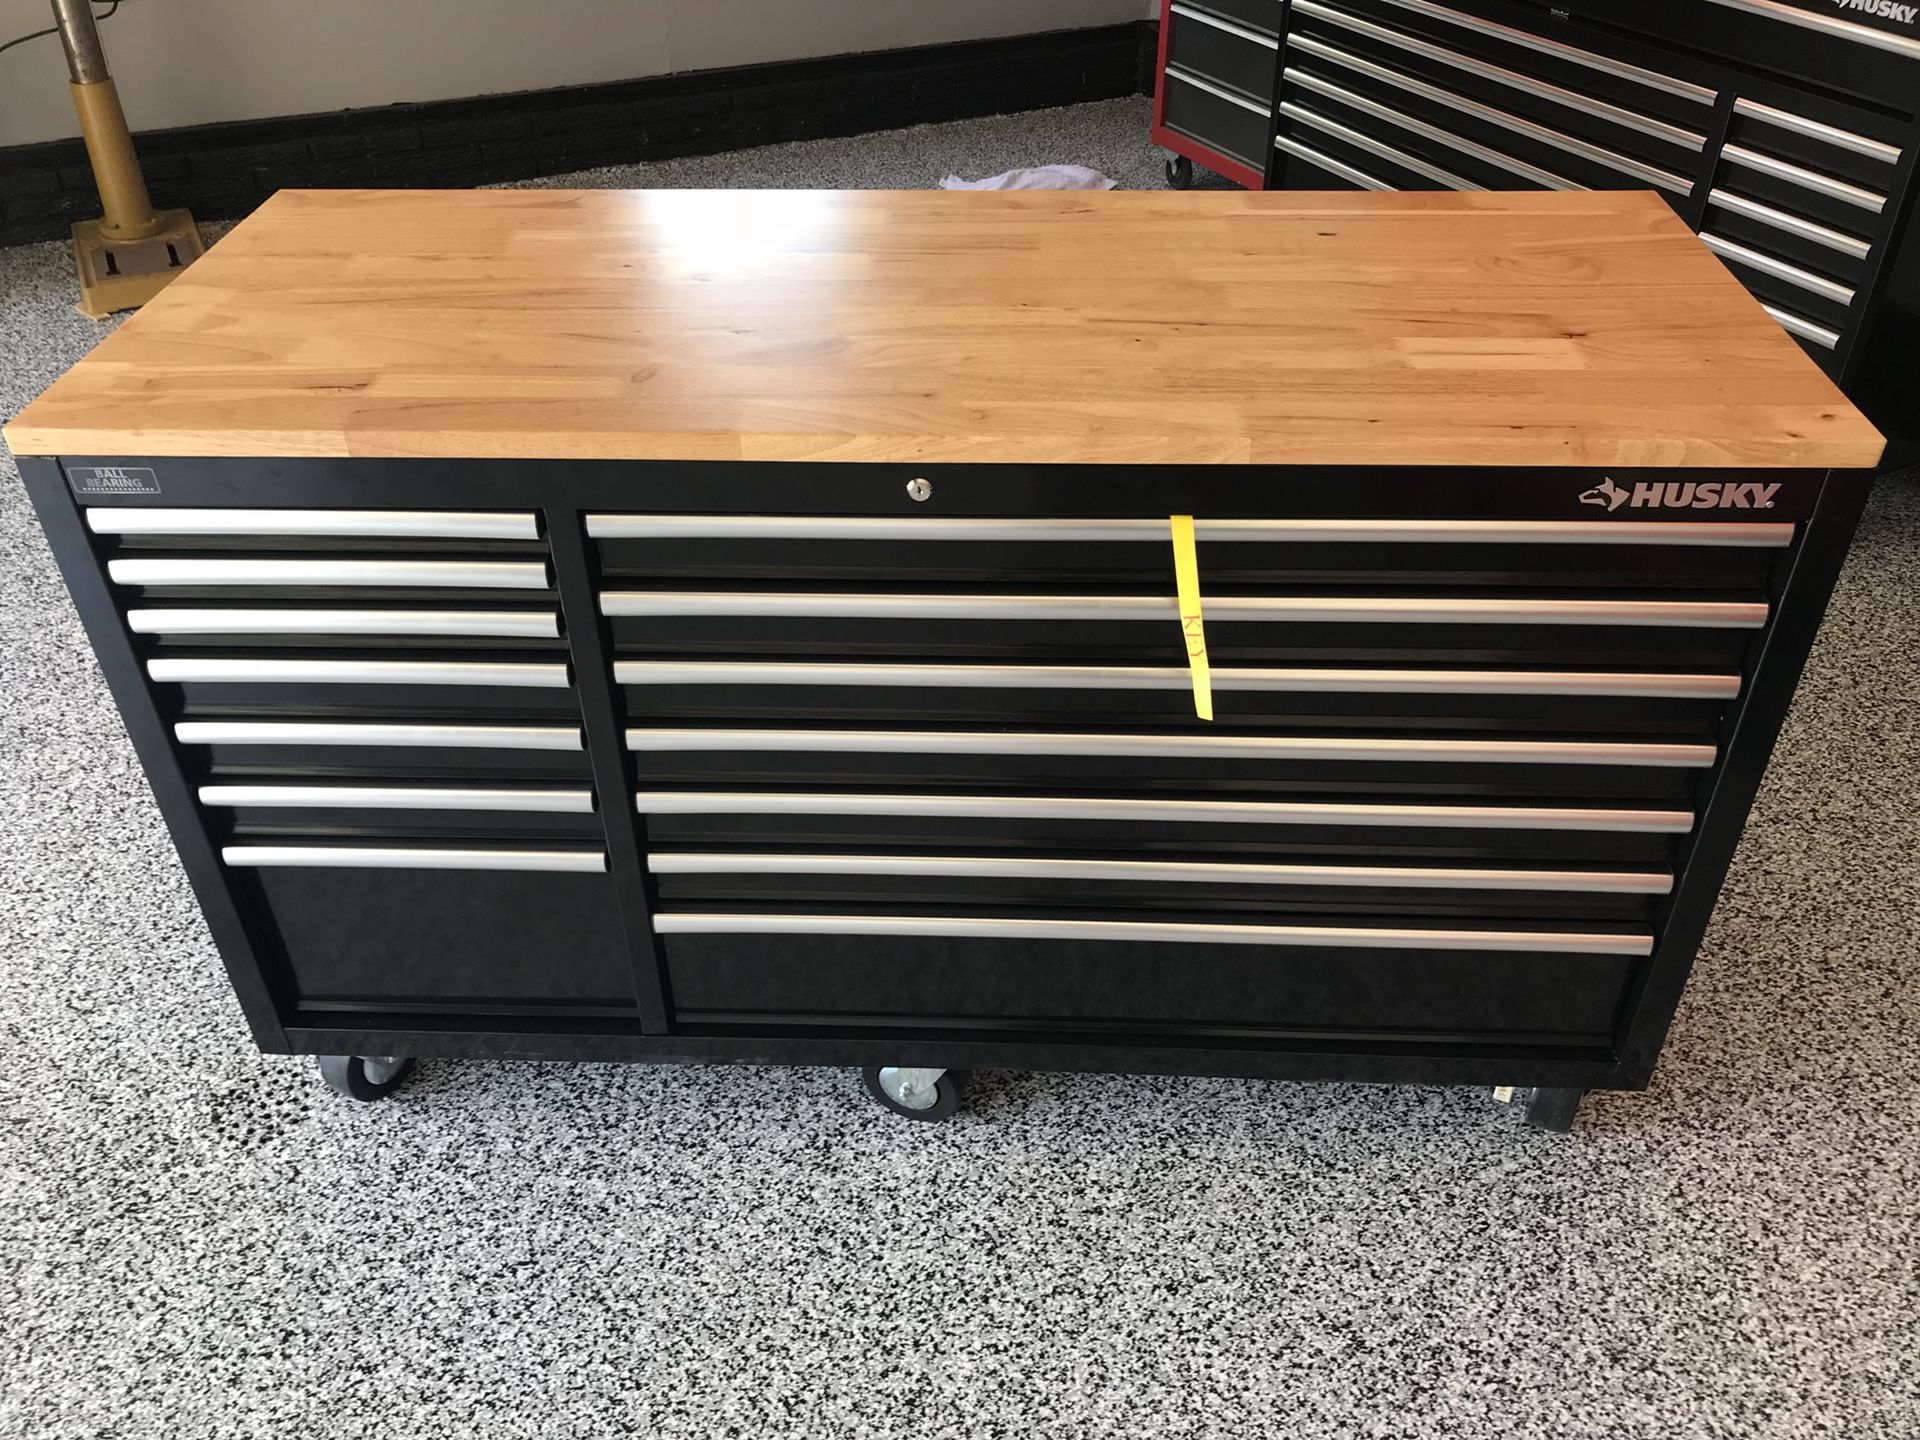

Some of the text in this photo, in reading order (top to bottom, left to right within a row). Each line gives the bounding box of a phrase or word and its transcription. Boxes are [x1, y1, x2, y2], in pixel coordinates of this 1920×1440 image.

[94, 469, 127, 478] BALL
[85, 478, 142, 487] BEARING
[1630, 482, 1782, 508] HUSKY
